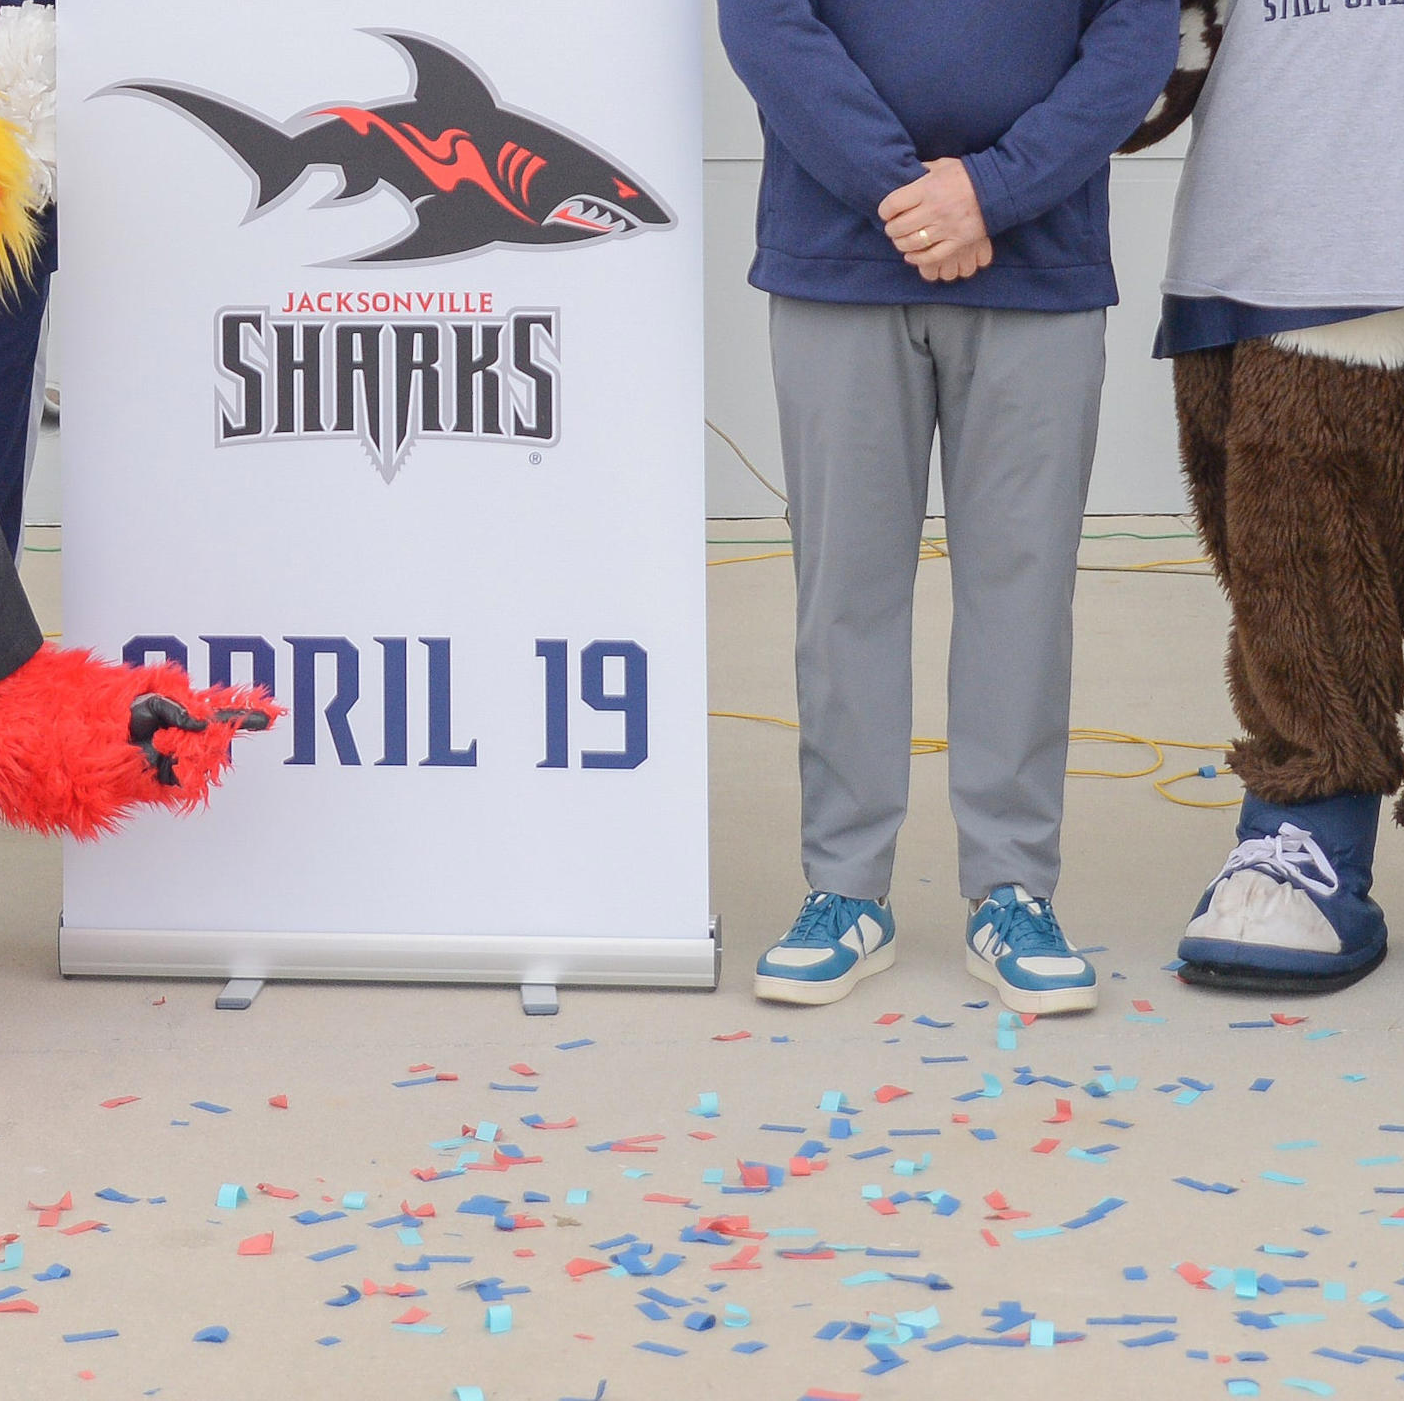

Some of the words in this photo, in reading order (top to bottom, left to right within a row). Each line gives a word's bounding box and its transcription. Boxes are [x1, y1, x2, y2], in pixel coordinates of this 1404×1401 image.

[282, 291, 493, 313] JACKSONVILLE
[219, 309, 556, 456] SHARKS
[122, 635, 478, 767] PRIL
[534, 638, 649, 770] 19
